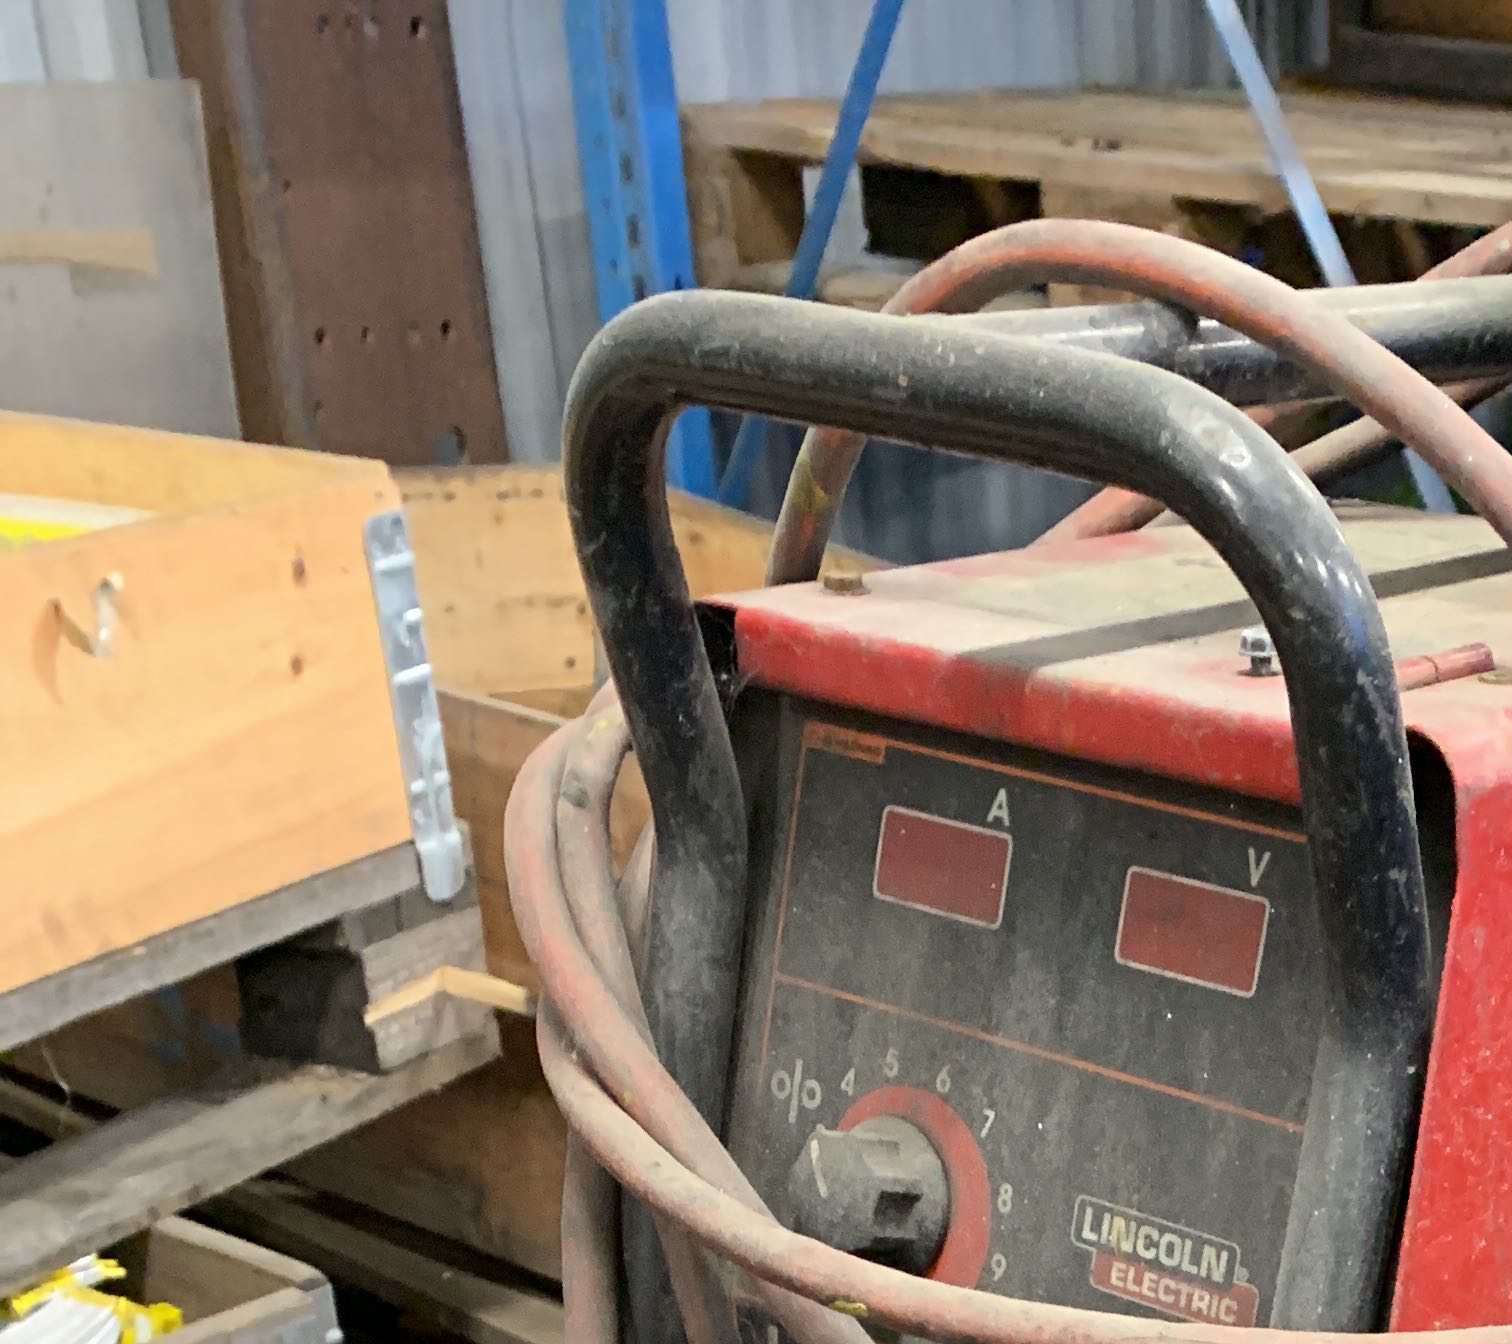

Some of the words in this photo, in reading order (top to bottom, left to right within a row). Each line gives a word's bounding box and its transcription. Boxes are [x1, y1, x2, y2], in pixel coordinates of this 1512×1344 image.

[986, 788, 1010, 827] A
[1247, 846, 1272, 888] V
[883, 1047, 899, 1078] 5
[840, 1067, 856, 1097] 4
[935, 1064, 951, 1093] 6
[980, 1107, 996, 1138] 7
[997, 1182, 1014, 1214] 8
[1081, 1206, 1229, 1284] LINCOLN
[991, 1252, 1007, 1282] 9
[1109, 1260, 1239, 1323] ELECTRIC
